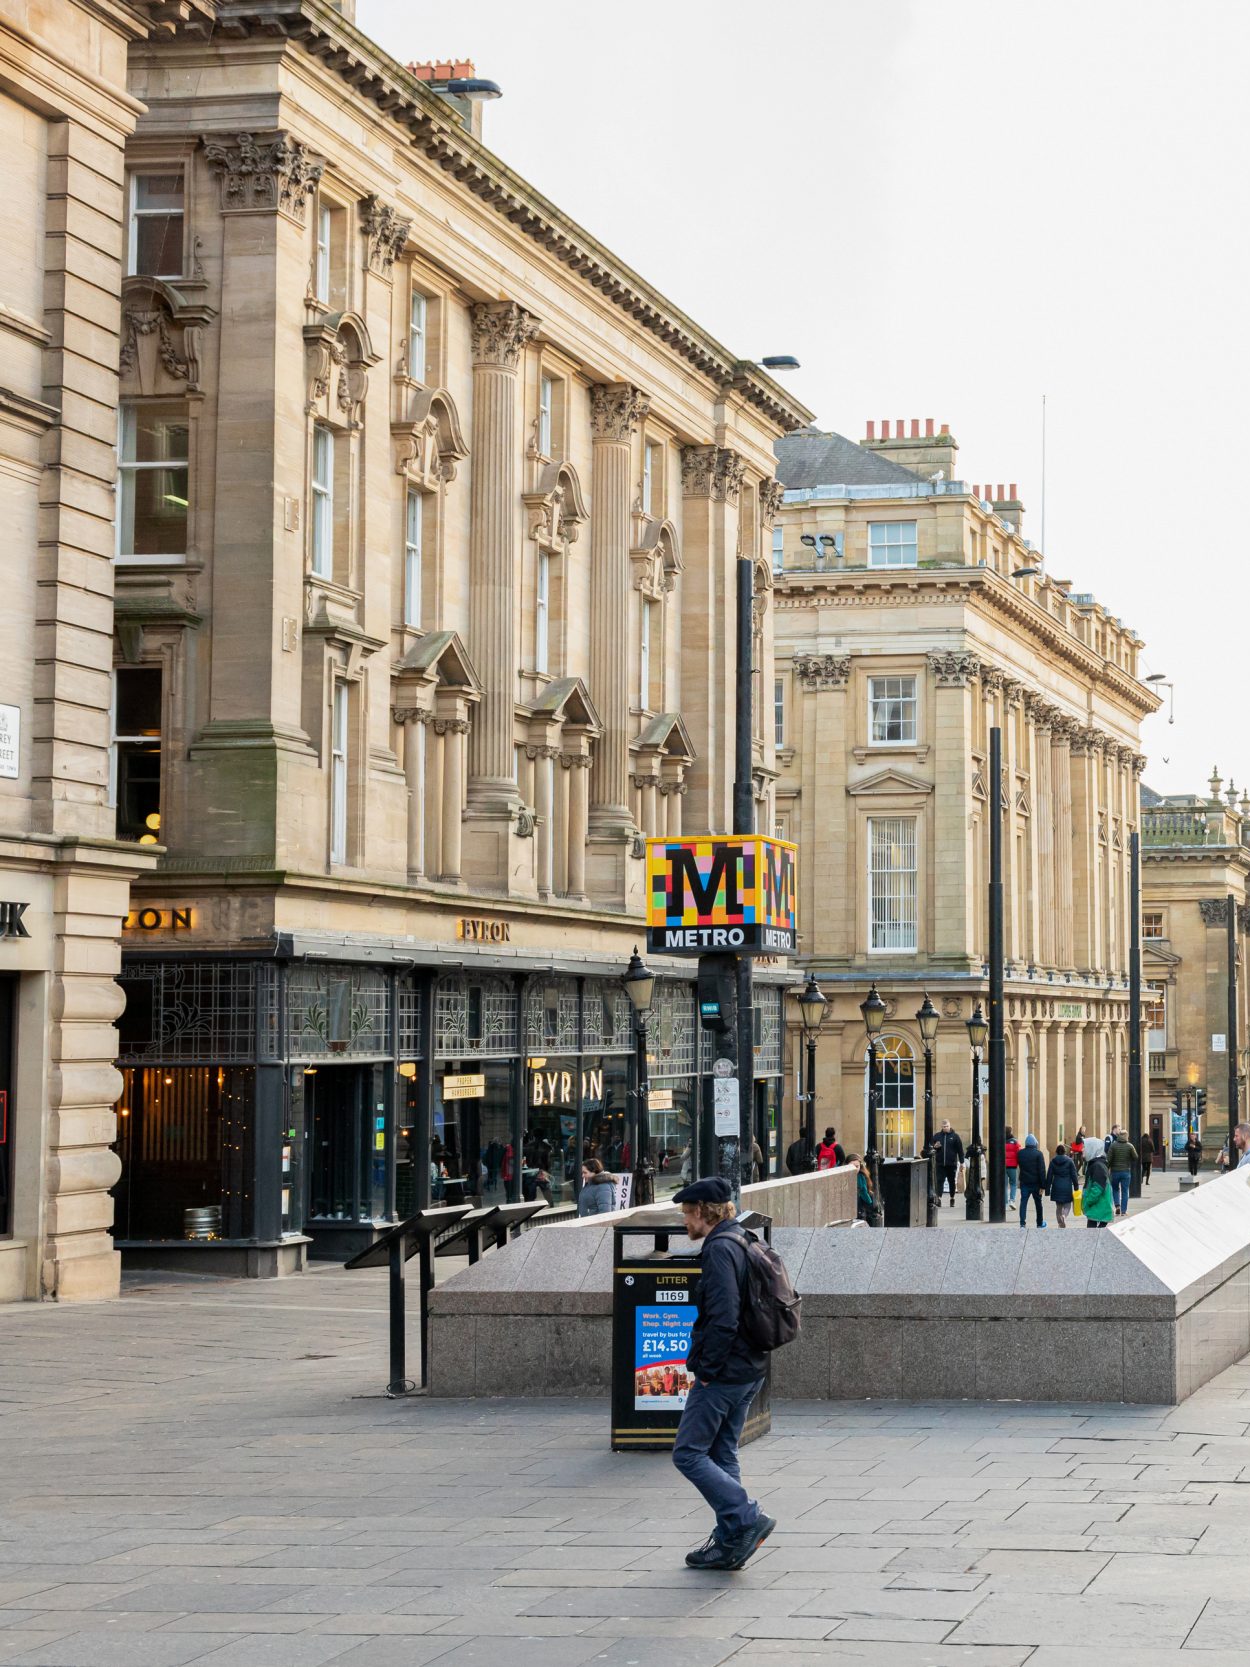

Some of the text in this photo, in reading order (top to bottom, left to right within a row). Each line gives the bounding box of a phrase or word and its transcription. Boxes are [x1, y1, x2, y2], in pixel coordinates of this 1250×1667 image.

[665, 847, 744, 917] M
[766, 848, 790, 919] M
[460, 919, 510, 941] BYRON
[665, 928, 745, 948] METRO
[766, 929, 791, 949] METRO
[656, 1276, 688, 1285] LITTER
[660, 1292, 684, 1301] 1169
[642, 1339, 688, 1352] £14.50
